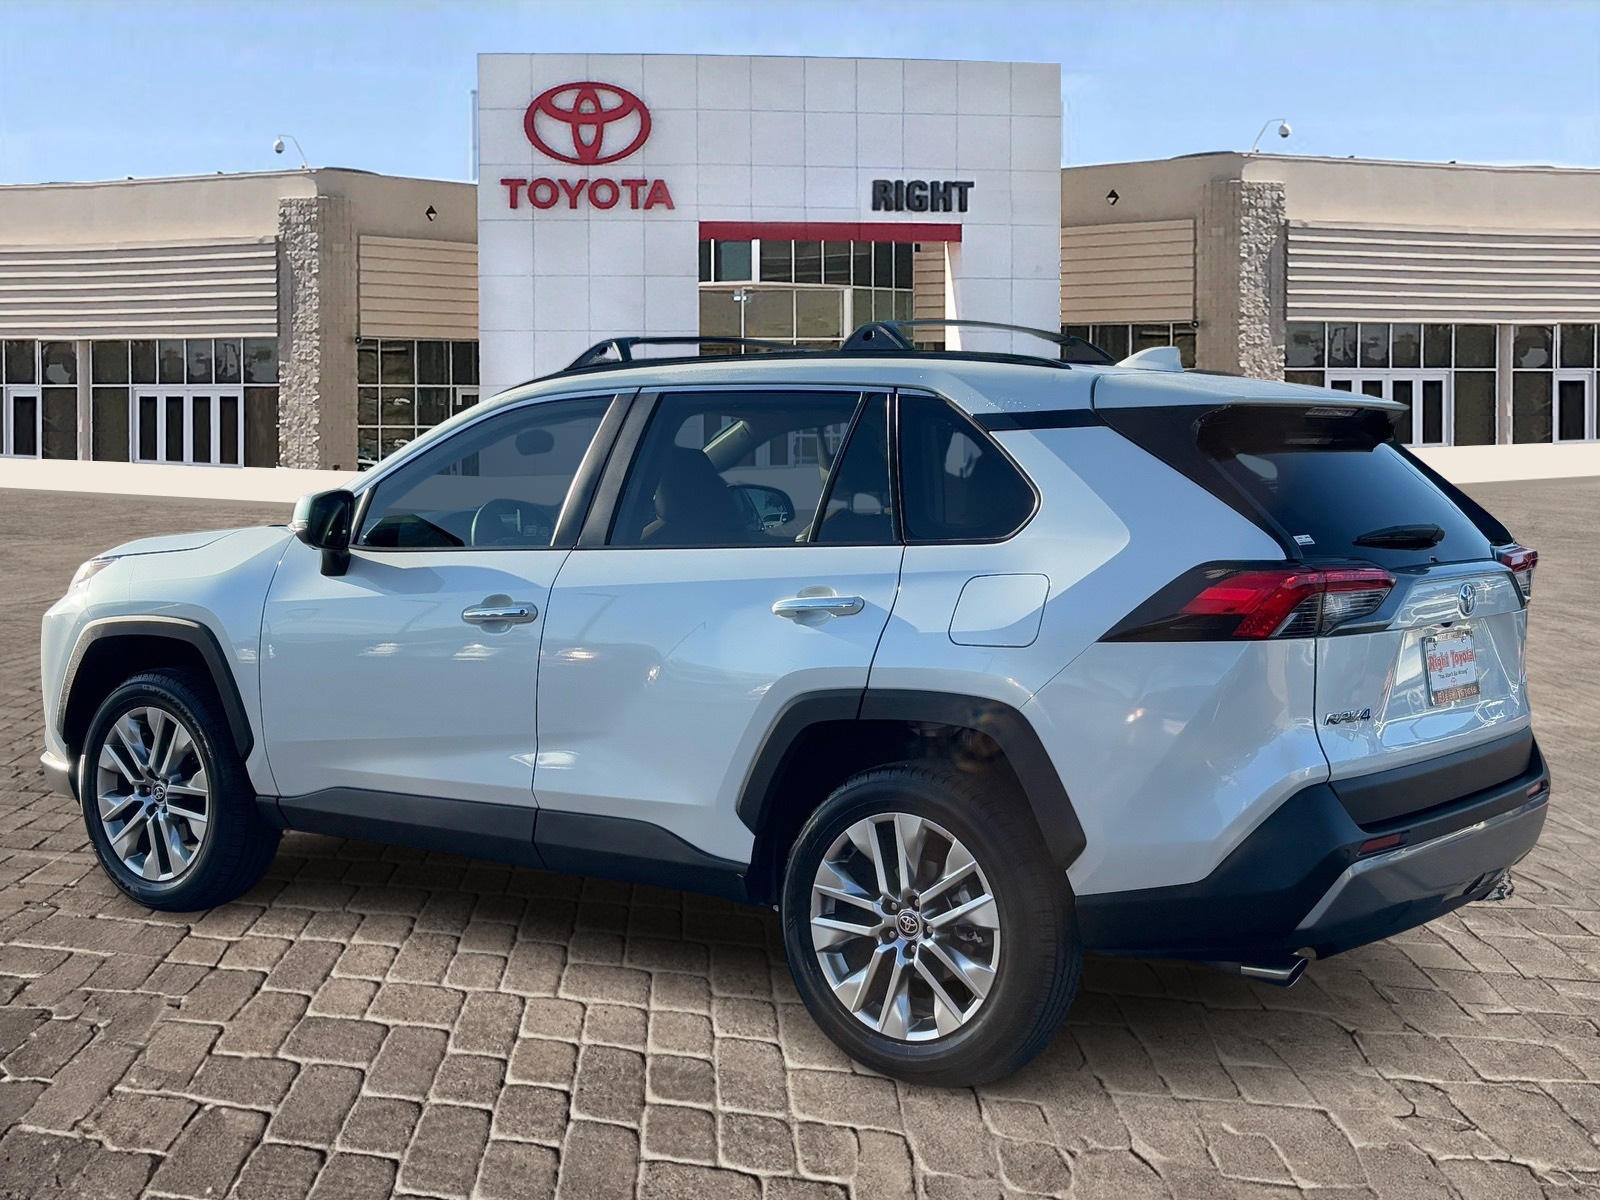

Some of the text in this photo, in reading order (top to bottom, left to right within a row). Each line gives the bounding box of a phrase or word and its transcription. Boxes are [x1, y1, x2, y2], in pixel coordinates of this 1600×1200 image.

[500, 178, 675, 210] TOYOTA
[871, 179, 975, 213] RIGHT
[1323, 708, 1371, 726] RAV4
